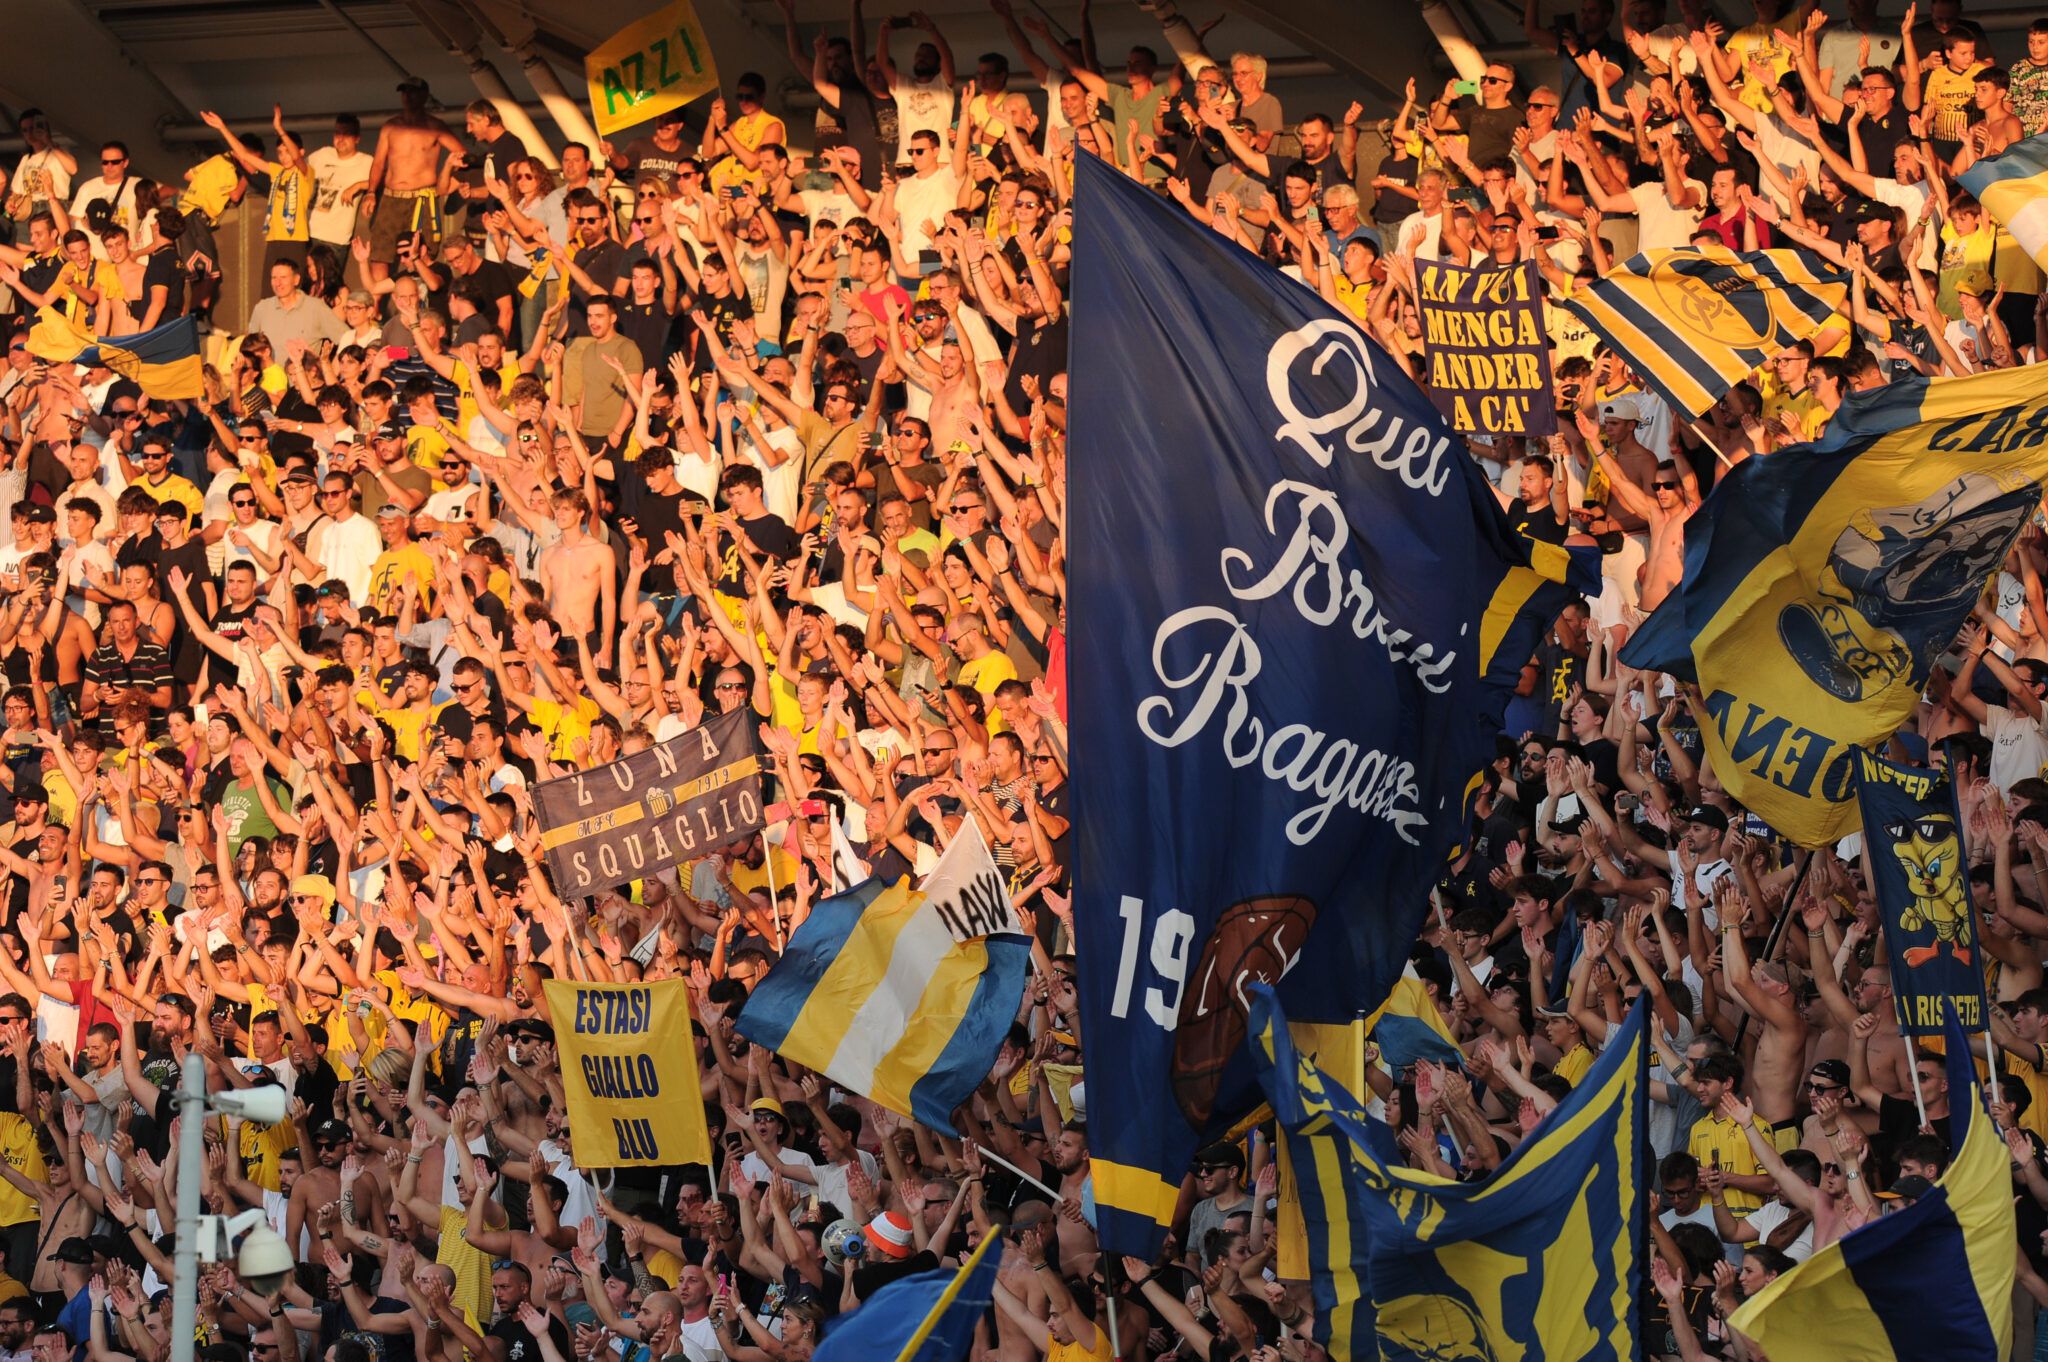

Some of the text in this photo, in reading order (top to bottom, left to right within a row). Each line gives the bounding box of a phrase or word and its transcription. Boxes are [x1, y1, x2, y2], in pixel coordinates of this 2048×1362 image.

[602, 27, 702, 115] AZZI
[1421, 266, 1467, 304] AN
[1423, 308, 1541, 347] MENGA
[1431, 351, 1543, 390] ANDER
[1266, 317, 1451, 496] Quei
[1453, 396, 1530, 432] A CA'
[569, 725, 718, 807] ZONA
[577, 768, 730, 838] MFC 1912
[571, 789, 756, 888] SQUAGLIO
[575, 989, 651, 1034] ESTASI
[581, 1054, 660, 1098] GIALLO
[612, 1118, 659, 1160] BLU
